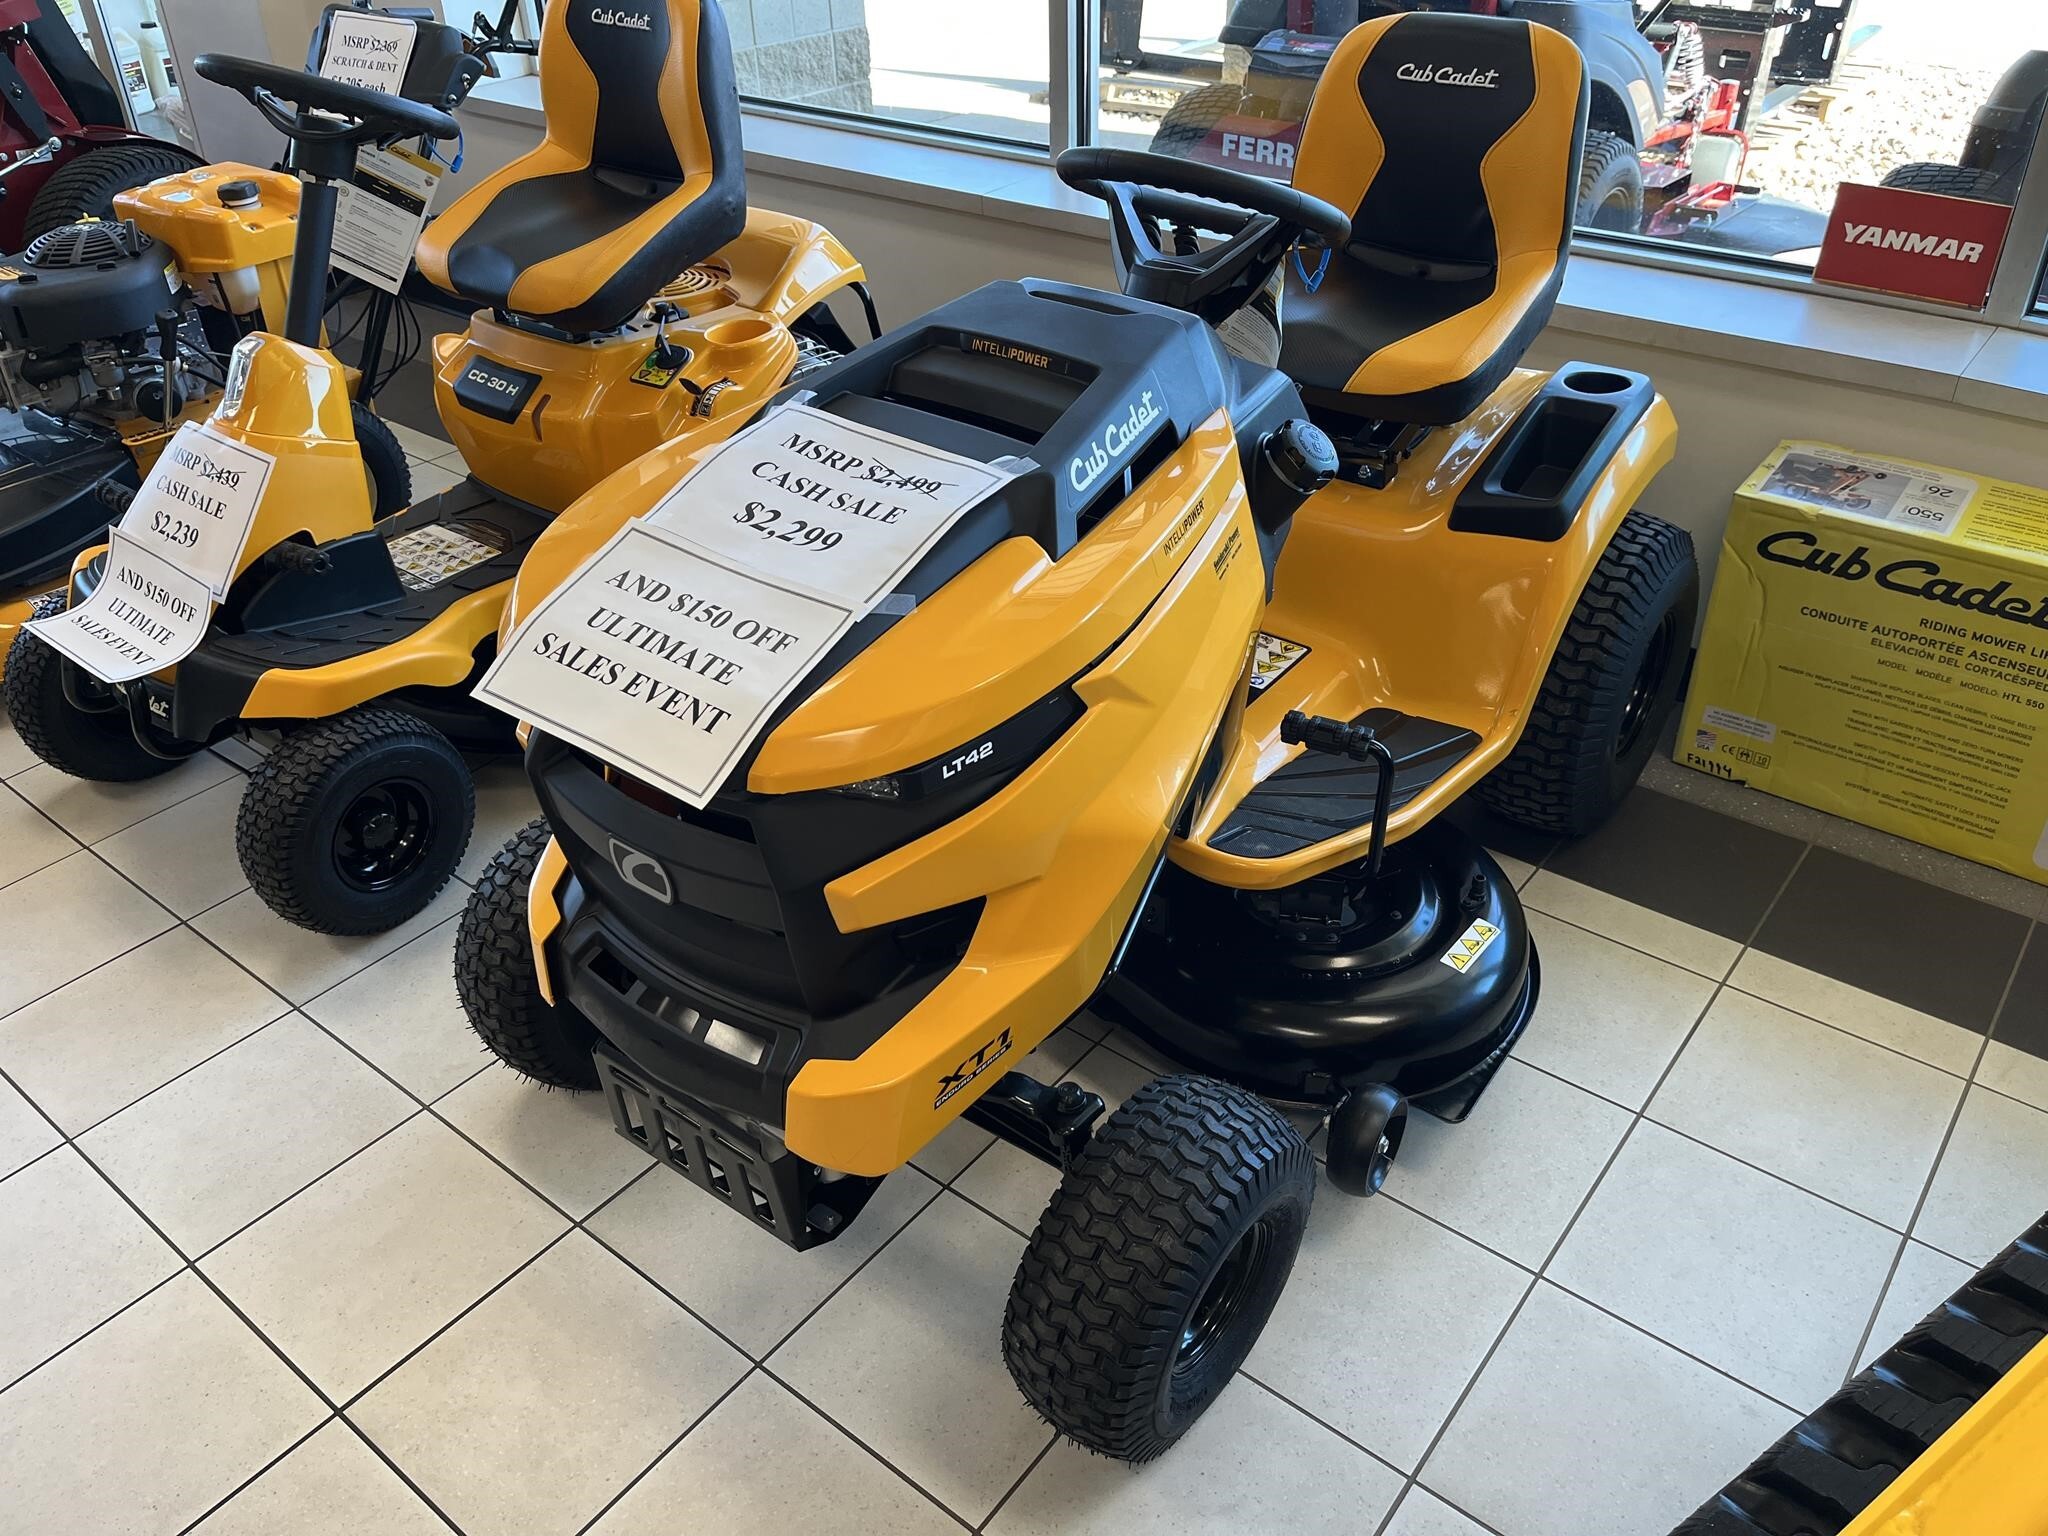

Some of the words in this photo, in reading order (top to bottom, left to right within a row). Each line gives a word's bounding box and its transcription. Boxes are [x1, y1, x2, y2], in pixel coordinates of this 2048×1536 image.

[591, 8, 614, 25] Cub
[615, 11, 651, 30] Cadet
[341, 35, 369, 50] MSRP
[332, 56, 367, 69] SCRATCH
[367, 61, 374, 70] &
[375, 62, 398, 73] DENT
[1396, 63, 1433, 82] Cub
[1434, 67, 1499, 88] Cadet
[1222, 133, 1295, 168] FERR
[1843, 222, 1984, 263] YANMAR
[972, 339, 1048, 368] INTELLIPOWER
[468, 369, 488, 383] CC
[487, 377, 507, 391] 30
[505, 384, 519, 396] H
[169, 446, 201, 470] MSRP
[780, 433, 864, 473] MSRP
[1070, 441, 1108, 492] Cub
[1105, 390, 1160, 457] Cadet
[156, 475, 189, 502] CASH
[188, 490, 227, 520] SALE
[751, 460, 834, 503] CASH
[829, 492, 908, 525] SALE
[150, 510, 199, 548] $2,239
[732, 501, 843, 552] $2,299
[1163, 499, 1204, 556] INTELLIPOWER
[1757, 531, 1871, 581] Cub
[116, 566, 144, 591] AND
[143, 581, 170, 608] $150
[170, 597, 197, 622] OFF
[604, 569, 671, 603] AND
[668, 593, 733, 629] $150
[732, 619, 799, 654] OFF
[71, 614, 115, 640] SALES
[105, 637, 156, 665] EVENT
[108, 597, 175, 646] ULTIMATE
[1919, 618, 1967, 638] RIDING
[1971, 631, 2026, 654] MOWER
[586, 606, 744, 686] ULTIMATE
[1800, 606, 1869, 631] CONDUITE
[1871, 625, 1966, 656] AUTOPORTÉE
[1967, 650, 2048, 679] ASCENSEU
[1870, 637, 1935, 660] ELEVACIÓN
[1937, 655, 1961, 668] DEL
[533, 632, 627, 686] SALES
[619, 672, 732, 735] EVENT
[2002, 691, 2022, 704] HTL
[2025, 698, 2046, 710] 550
[942, 741, 994, 779] LT42
[935, 1026, 1011, 1100] XT1
[935, 1074, 974, 1108] ENDURO
